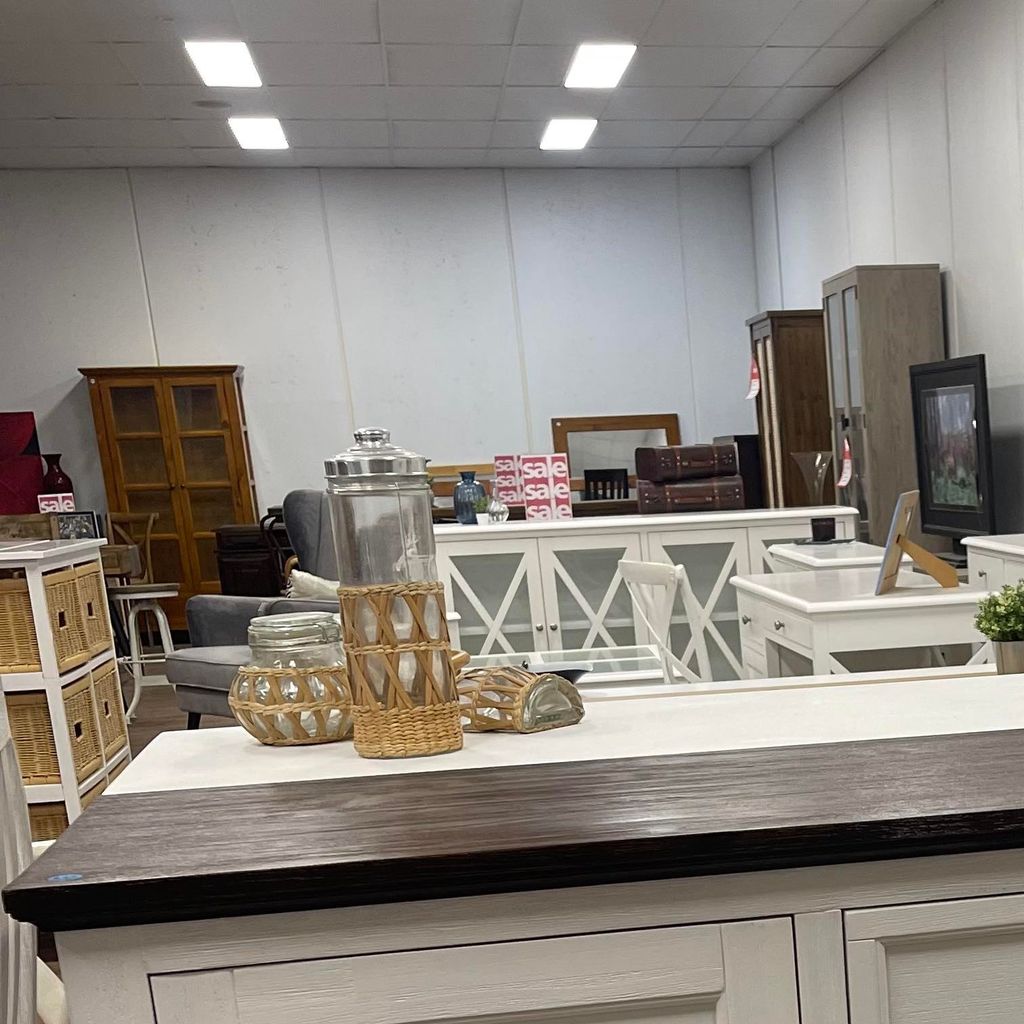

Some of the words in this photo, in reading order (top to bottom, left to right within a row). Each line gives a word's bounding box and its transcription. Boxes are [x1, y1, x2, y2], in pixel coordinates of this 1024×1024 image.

[495, 456, 521, 471] sal
[522, 457, 566, 478] sale
[496, 472, 523, 487] sal
[498, 488, 525, 502] sal
[525, 479, 569, 500] sale
[40, 496, 75, 513] sale
[527, 500, 571, 520] sale
